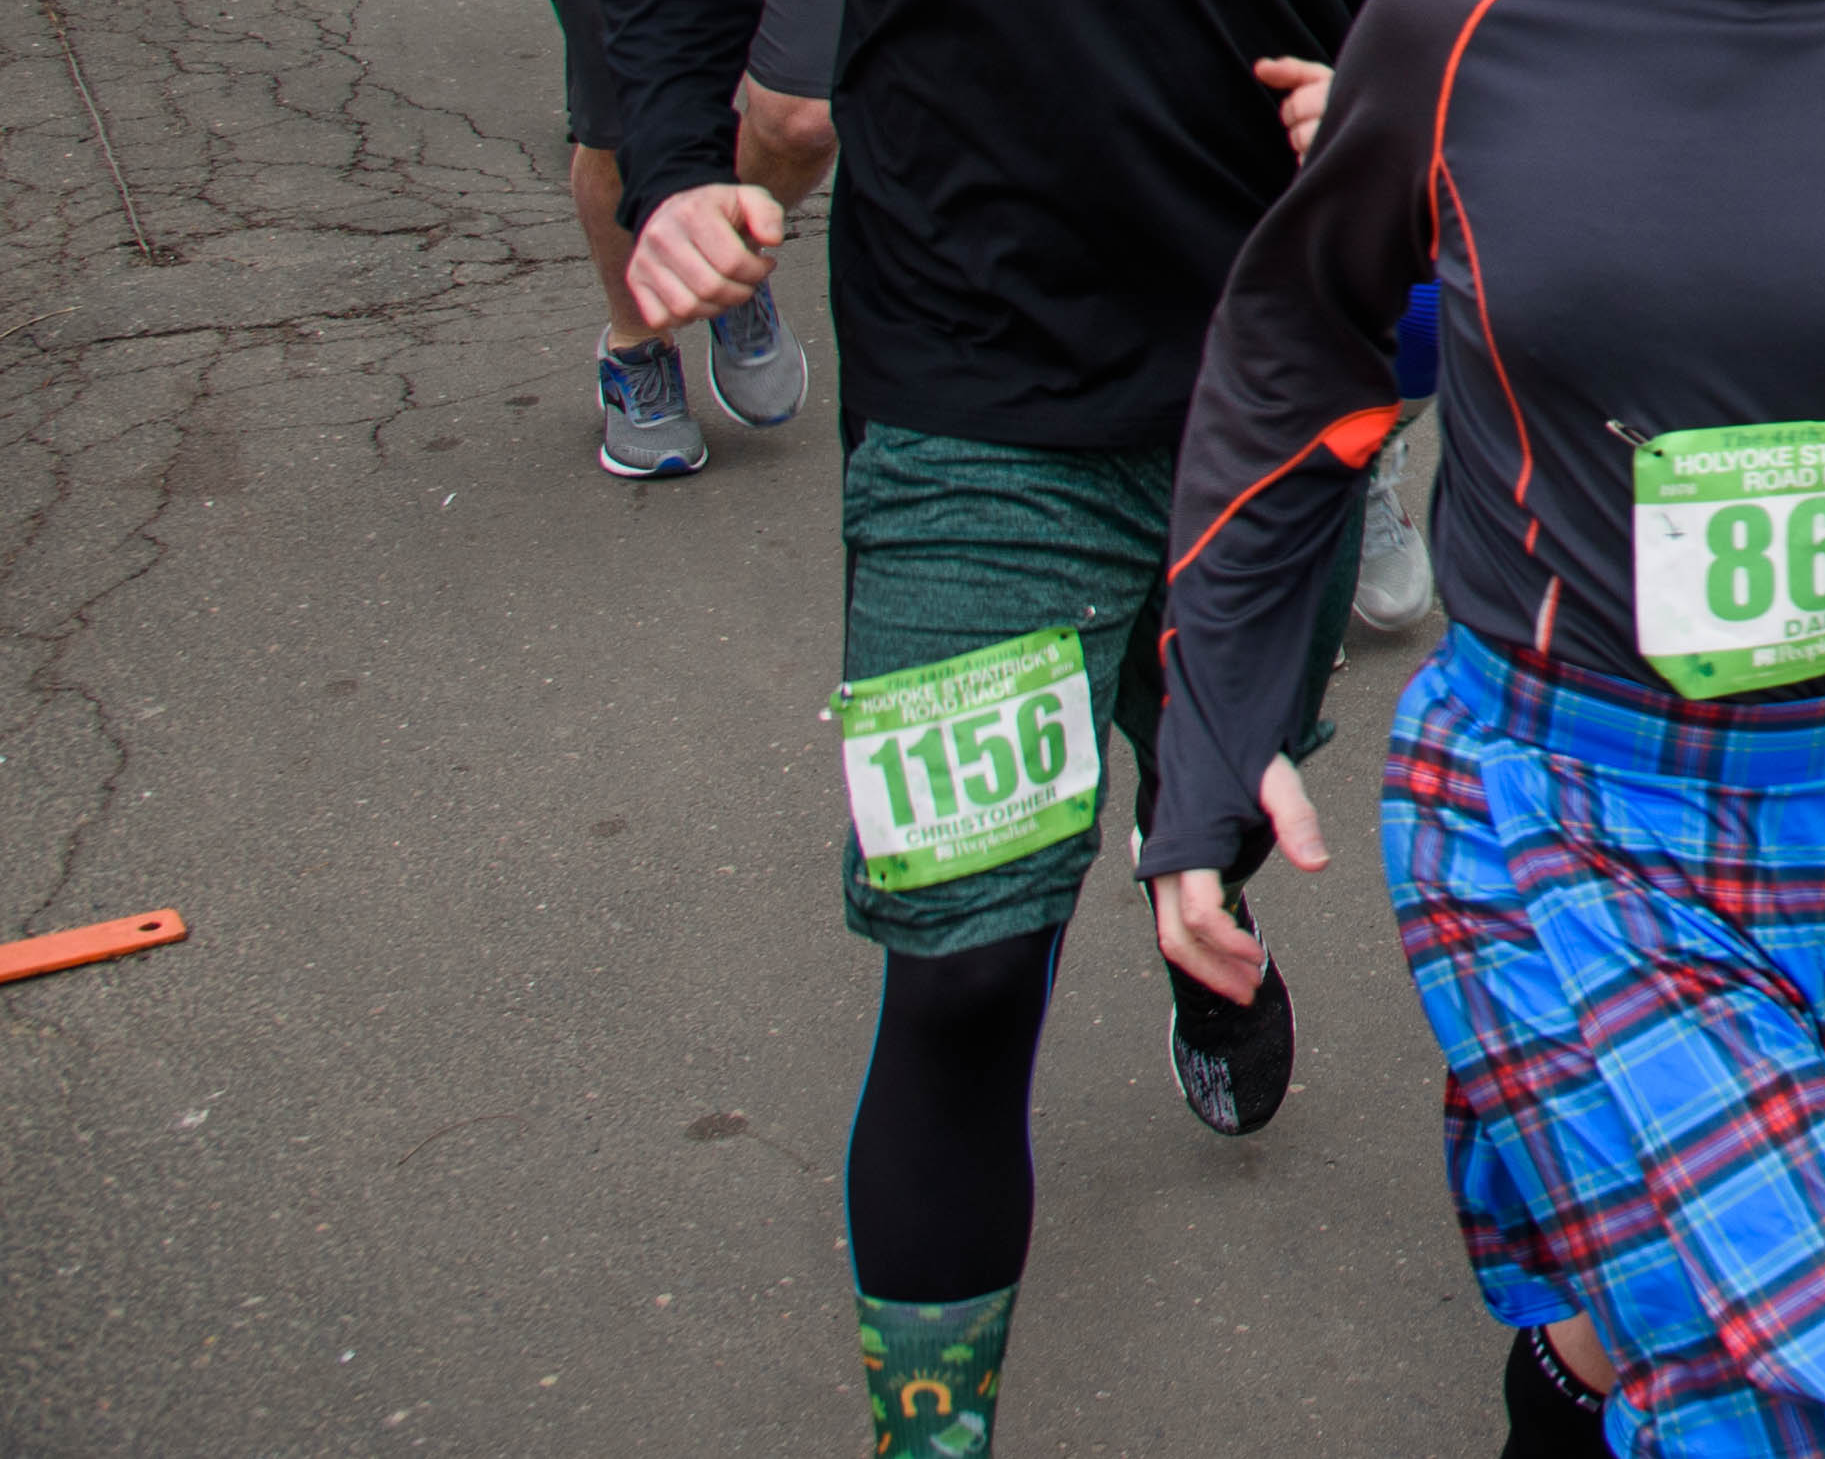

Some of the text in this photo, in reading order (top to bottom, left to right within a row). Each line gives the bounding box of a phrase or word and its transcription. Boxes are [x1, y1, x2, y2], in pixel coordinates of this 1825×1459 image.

[1673, 444, 1794, 476] HOLYOKE
[1742, 468, 1818, 493] ROAD
[861, 682, 937, 715] HOLYOKE
[903, 696, 959, 724] ROAD
[869, 692, 1067, 829] 1156
[904, 785, 1059, 844] CHRISTOPHER
